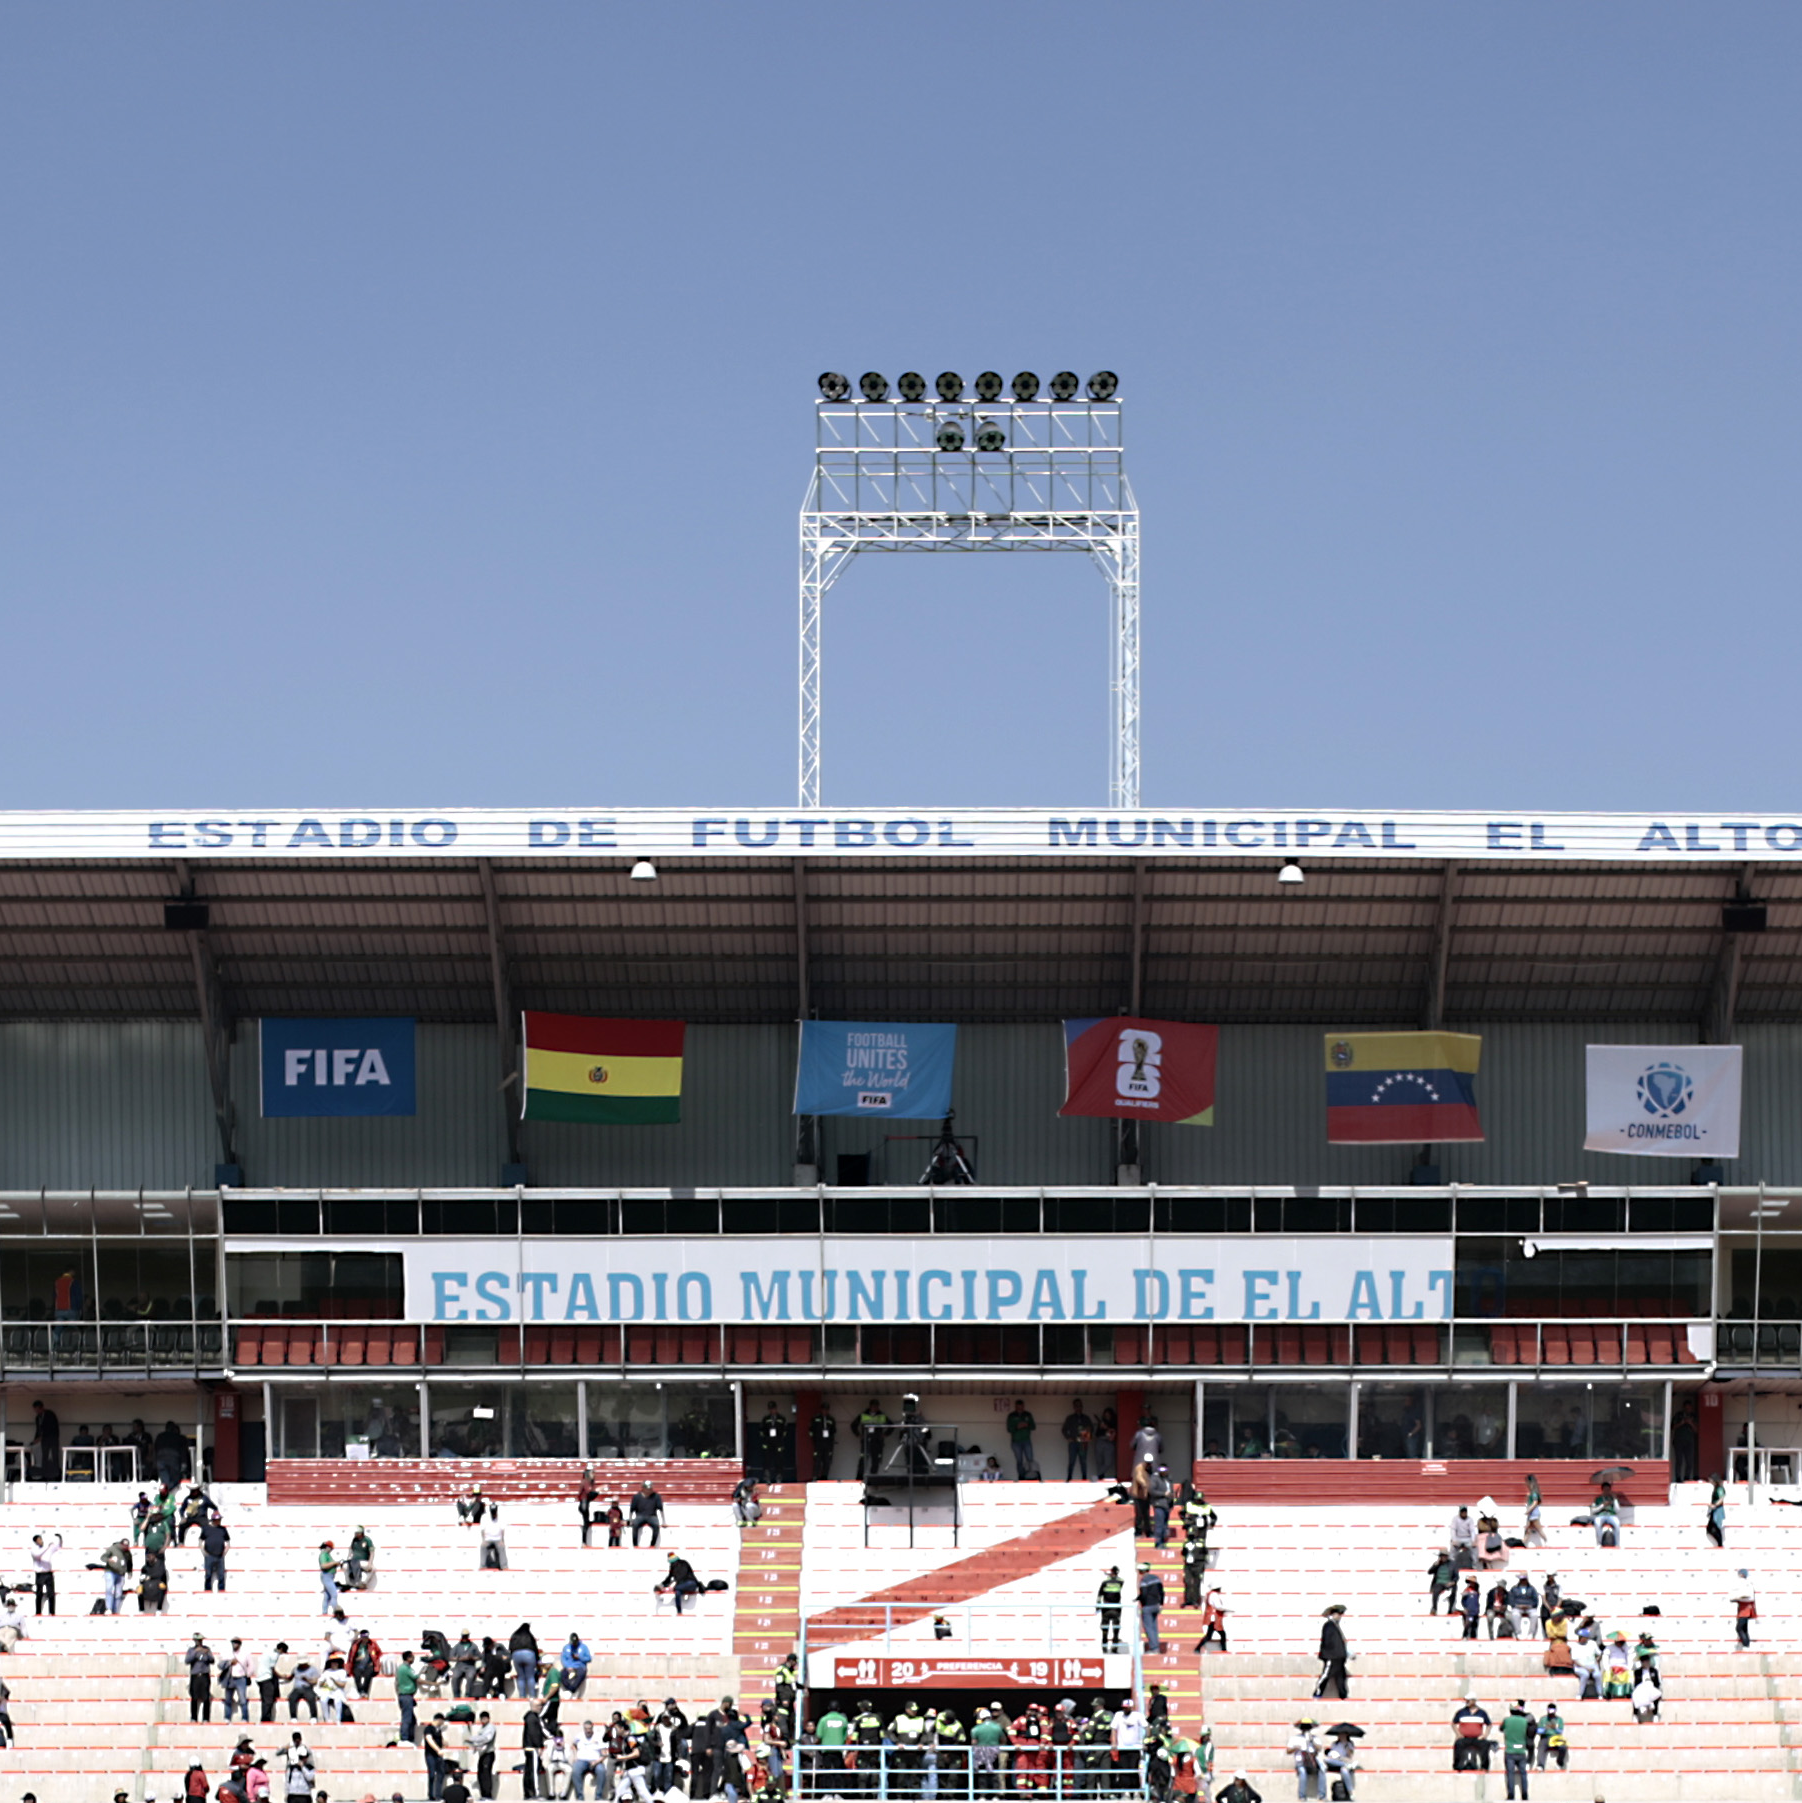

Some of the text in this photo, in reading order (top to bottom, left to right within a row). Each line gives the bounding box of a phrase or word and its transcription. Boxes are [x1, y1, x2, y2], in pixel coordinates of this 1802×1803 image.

[148, 819, 460, 848] ESTADIO
[529, 819, 618, 848] DE
[693, 818, 975, 848] FUTBOL
[1049, 818, 1416, 849] MUNICIPAL
[1487, 822, 1564, 850] EL
[847, 1033, 907, 1048] FOOTBALL
[284, 1048, 390, 1086] FIFA
[847, 1048, 908, 1070] UNITES
[841, 1070, 911, 1090] the World
[1129, 1083, 1148, 1091] FIFA
[862, 1096, 886, 1105] FIFA
[431, 1271, 712, 1320] ESTADIO
[740, 1269, 1106, 1320] MUNICIPAL
[1133, 1269, 1214, 1320] DE
[1242, 1270, 1320, 1320] EL
[891, 1662, 1048, 1677] 20 PREFERENCIA 19
